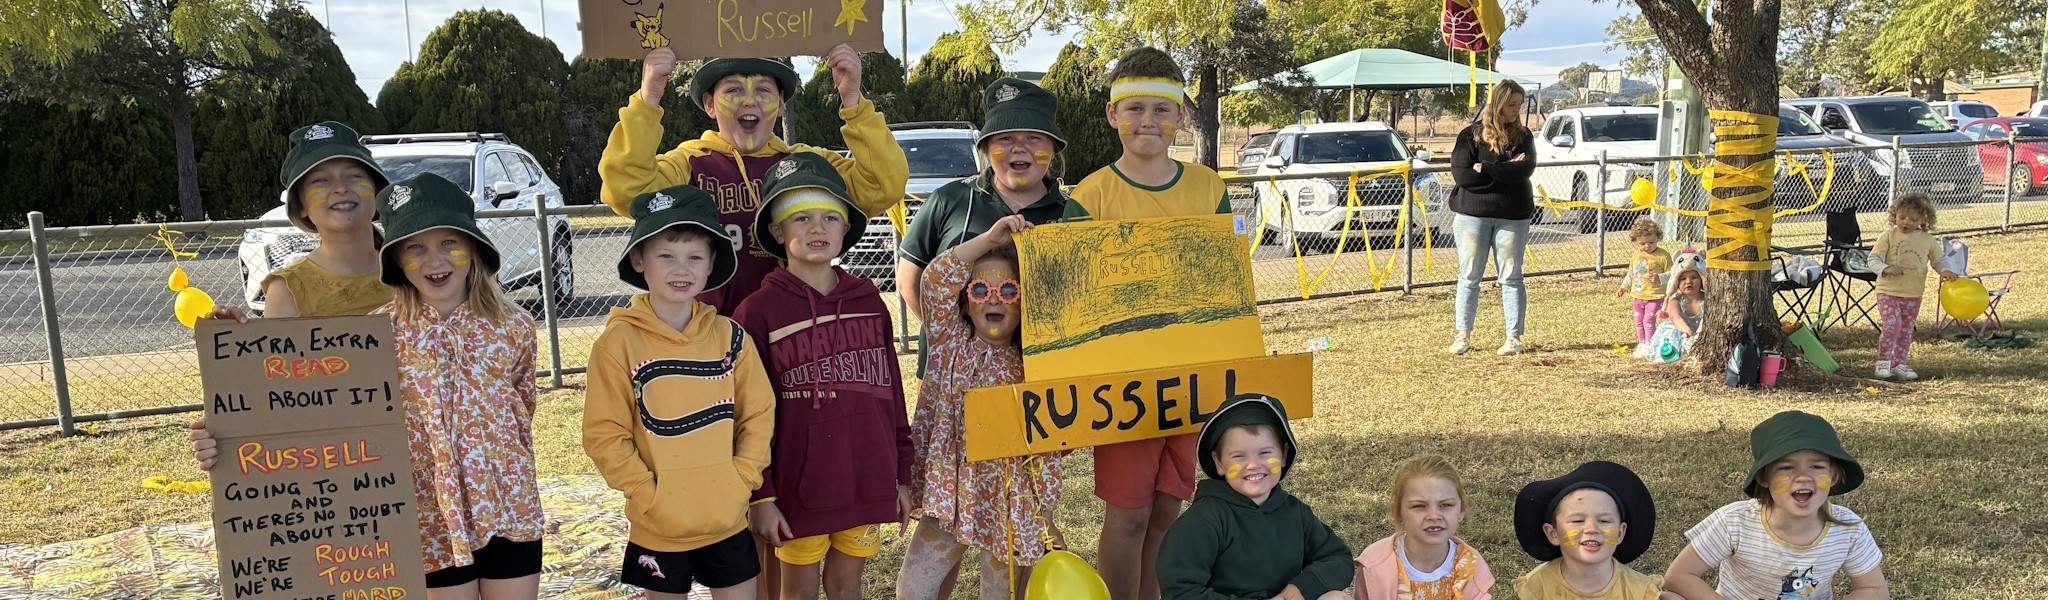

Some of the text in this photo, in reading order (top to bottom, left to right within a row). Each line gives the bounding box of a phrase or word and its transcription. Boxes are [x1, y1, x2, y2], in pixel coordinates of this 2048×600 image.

[717, 0, 813, 47] Russell
[310, 327, 379, 351] EXTRA
[263, 355, 350, 380] READ
[214, 393, 251, 414] ALL
[268, 388, 338, 410] ABOUT
[782, 391, 801, 399] STATE
[237, 439, 382, 475] RUSSELL
[224, 482, 301, 501] GOING
[353, 472, 396, 491] WIN
[223, 511, 305, 533] THERES
[349, 502, 406, 520] DOUBT
[291, 496, 333, 511] AND
[270, 519, 380, 547] ABOUT IT!
[231, 540, 392, 579] WE'RE ROUGH
[234, 562, 398, 599] WE'RE TOUGH
[341, 586, 407, 600] HARD
